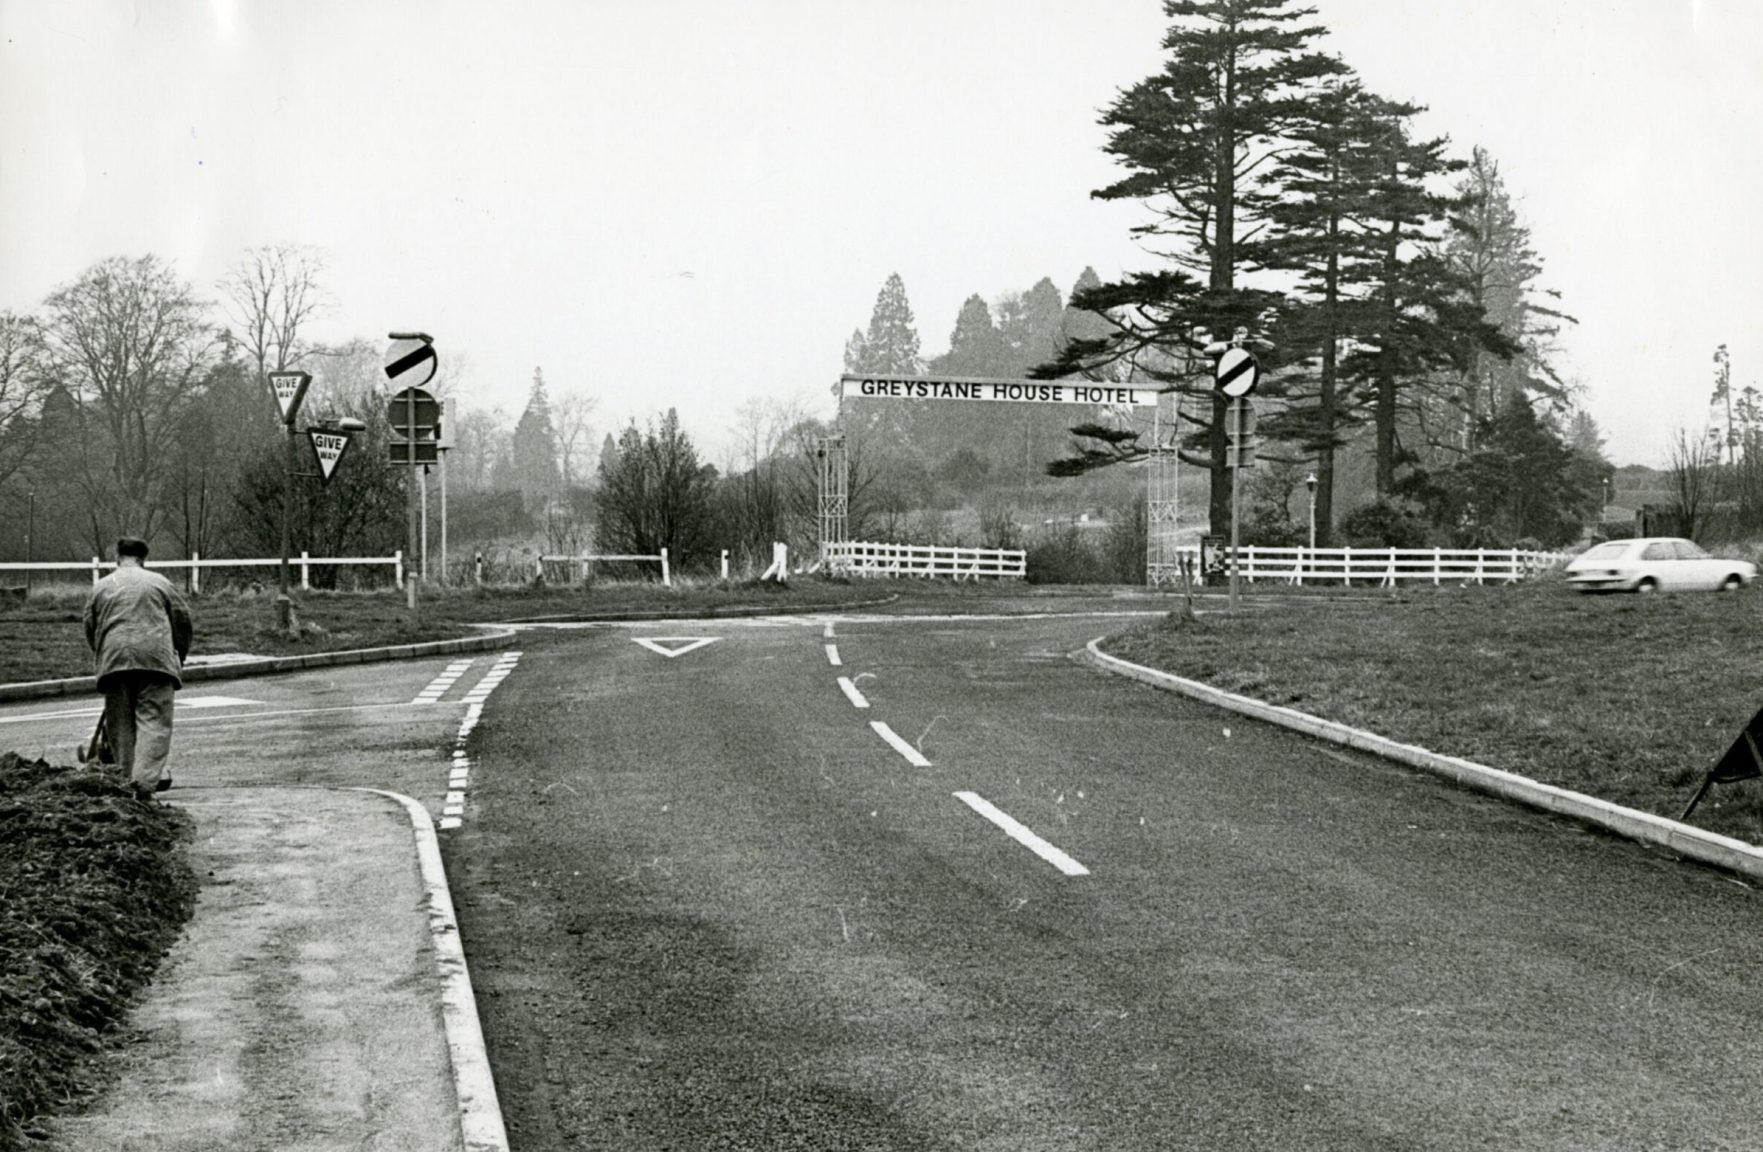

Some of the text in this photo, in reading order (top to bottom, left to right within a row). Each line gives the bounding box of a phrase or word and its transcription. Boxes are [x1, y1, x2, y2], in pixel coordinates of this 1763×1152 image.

[276, 378, 297, 389] GIVE
[861, 379, 1139, 404] GREYSTANE HOUSE HOTEL
[315, 436, 342, 450] GIVE
[320, 451, 338, 460] WAY
